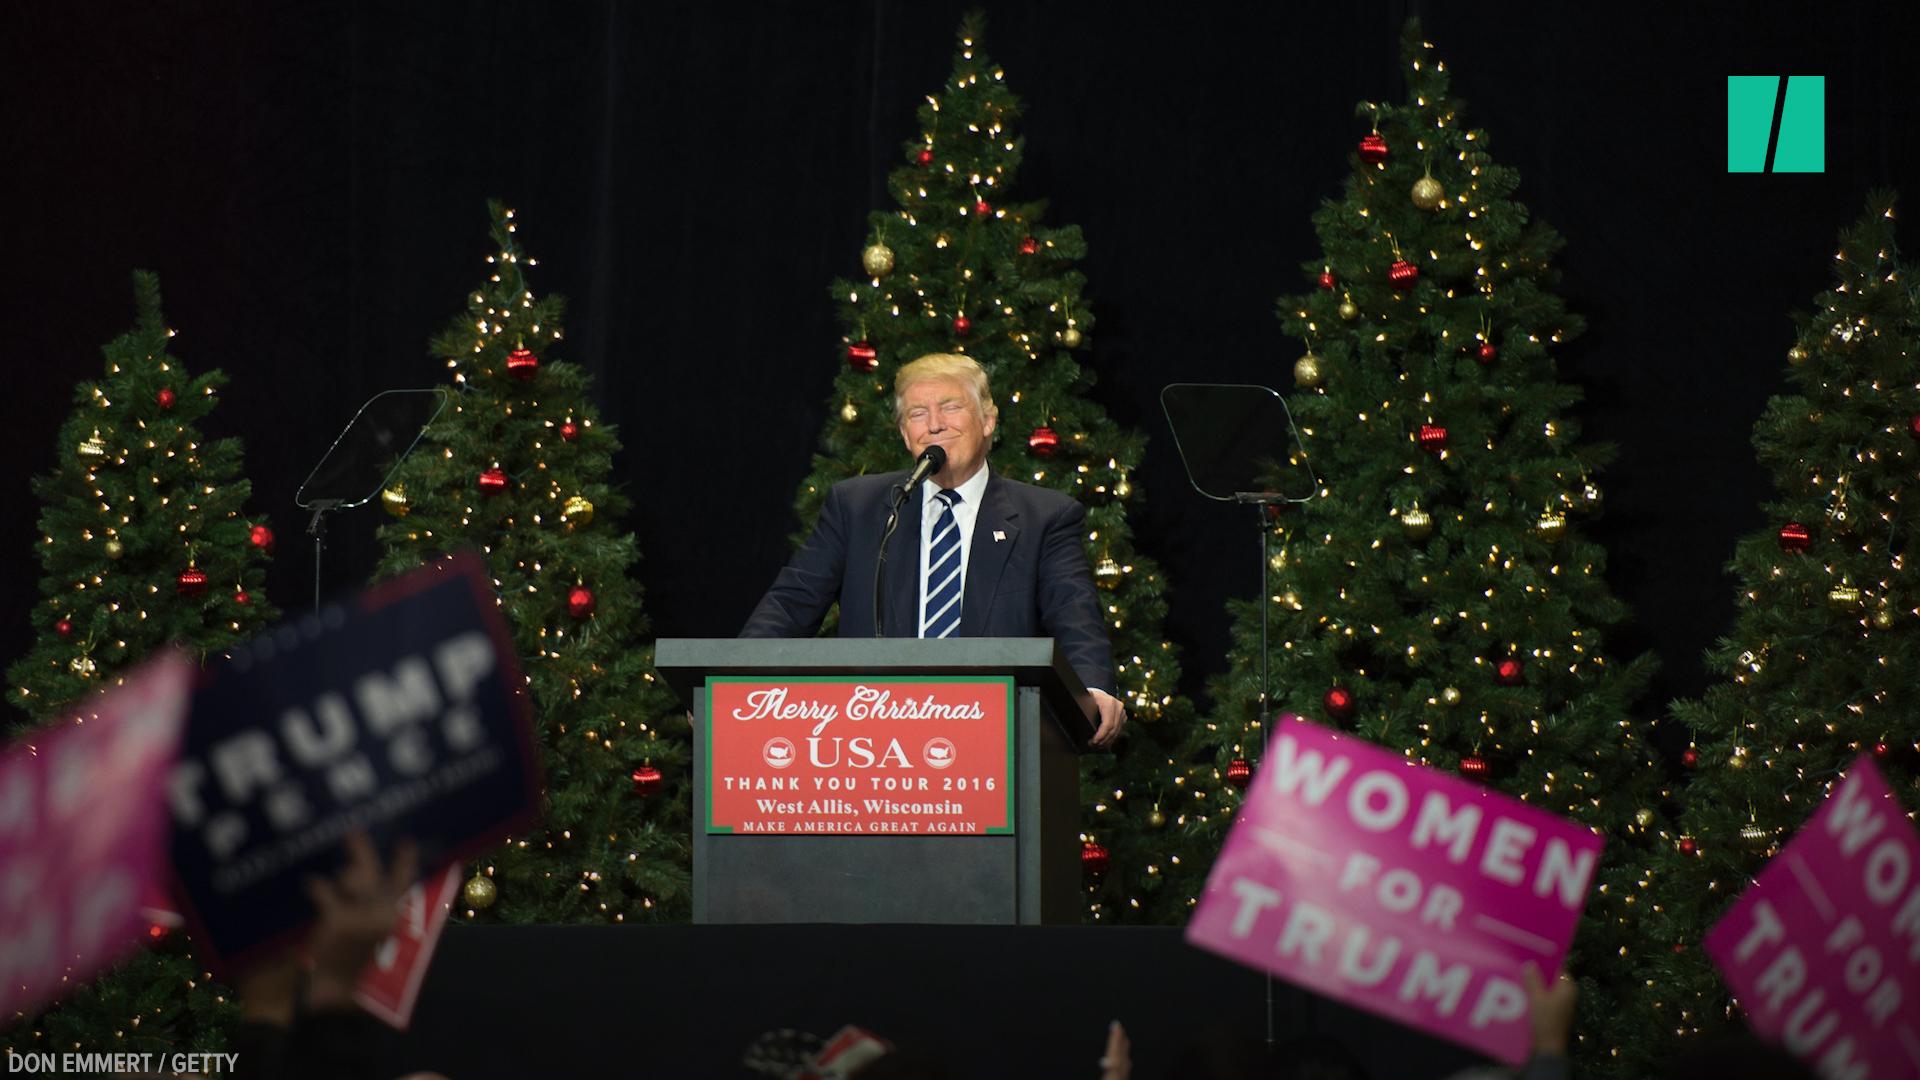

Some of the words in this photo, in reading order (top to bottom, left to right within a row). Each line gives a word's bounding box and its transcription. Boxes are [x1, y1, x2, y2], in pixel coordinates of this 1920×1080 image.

[166, 630, 497, 824] TRUMP
[732, 686, 839, 737] Merry
[845, 685, 985, 721] Christmas
[806, 737, 914, 769] USA
[724, 777, 801, 790] THANK
[814, 777, 857, 790] YOU
[871, 777, 929, 790] TOUR
[943, 777, 996, 790] 2016
[756, 799, 804, 814] West
[807, 799, 859, 816] Allis,
[864, 799, 964, 815] Wisconsin
[743, 821, 786, 832] MAKE
[794, 821, 863, 832] AMERICA
[869, 821, 919, 832] GREAT
[927, 821, 977, 832] AGAIN
[1271, 733, 1596, 907] WOMEN
[1339, 850, 1464, 931] FOR
[1229, 878, 1530, 1028] TRUMP
